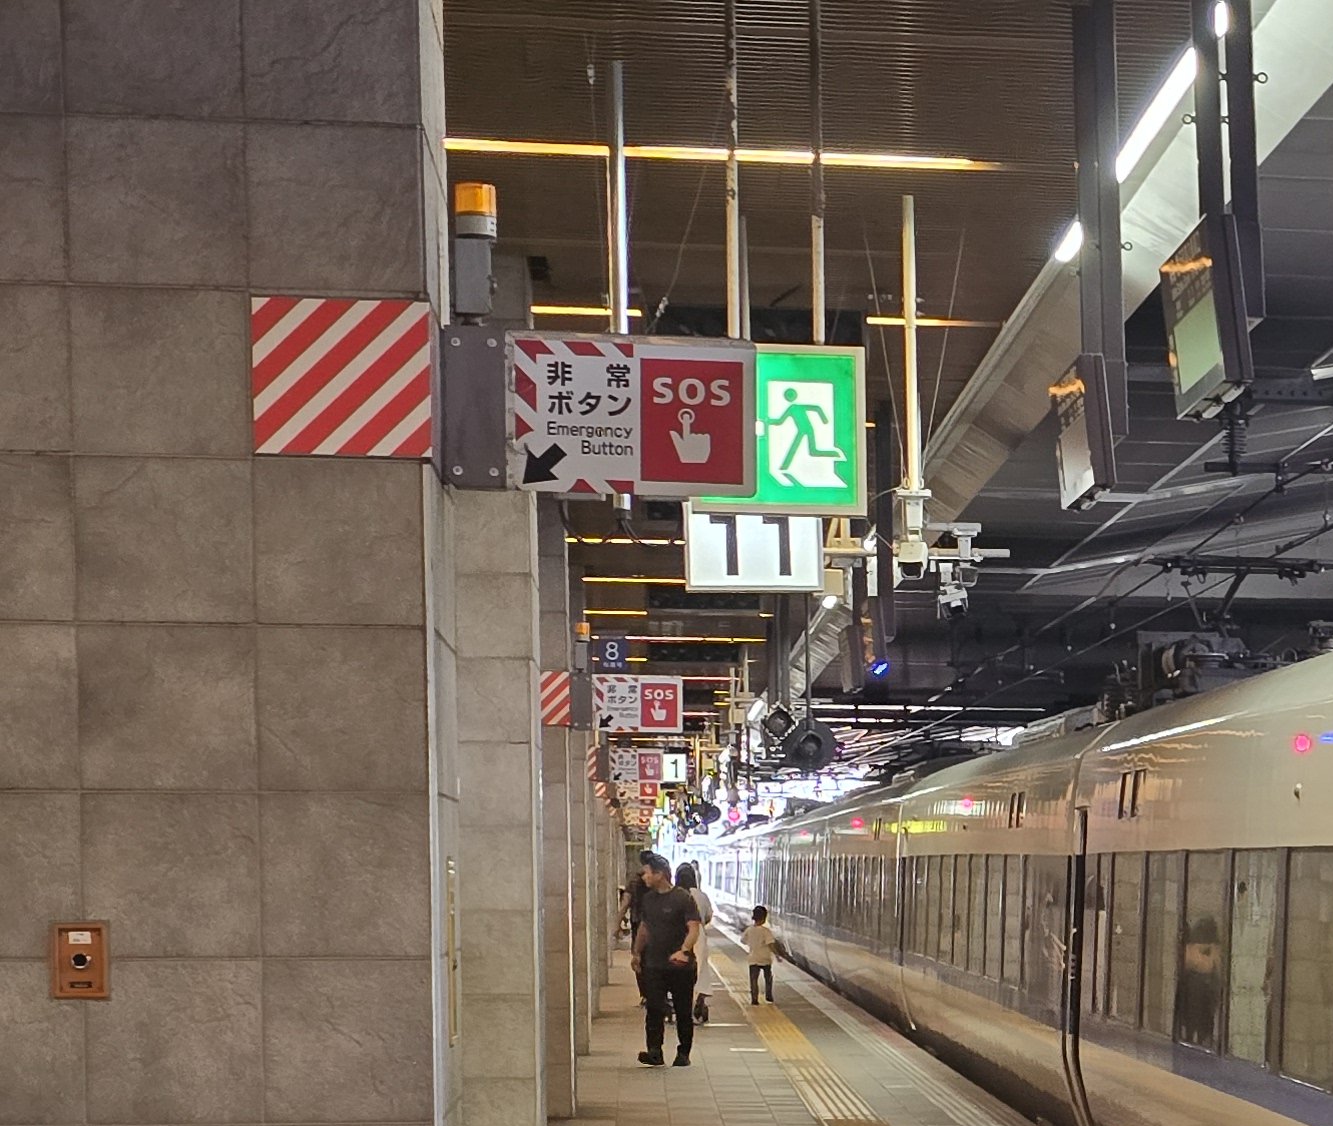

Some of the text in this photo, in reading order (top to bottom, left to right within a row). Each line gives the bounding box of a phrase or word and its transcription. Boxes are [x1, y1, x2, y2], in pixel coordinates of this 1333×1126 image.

[546, 360, 631, 388] 非常
[652, 376, 731, 406] SOS
[548, 390, 632, 416] ボタン
[546, 420, 633, 439] Emergency
[581, 439, 634, 456] Button
[709, 513, 791, 576] 11
[605, 641, 619, 660] 8
[644, 689, 674, 700] SOS
[671, 758, 679, 778] 1
